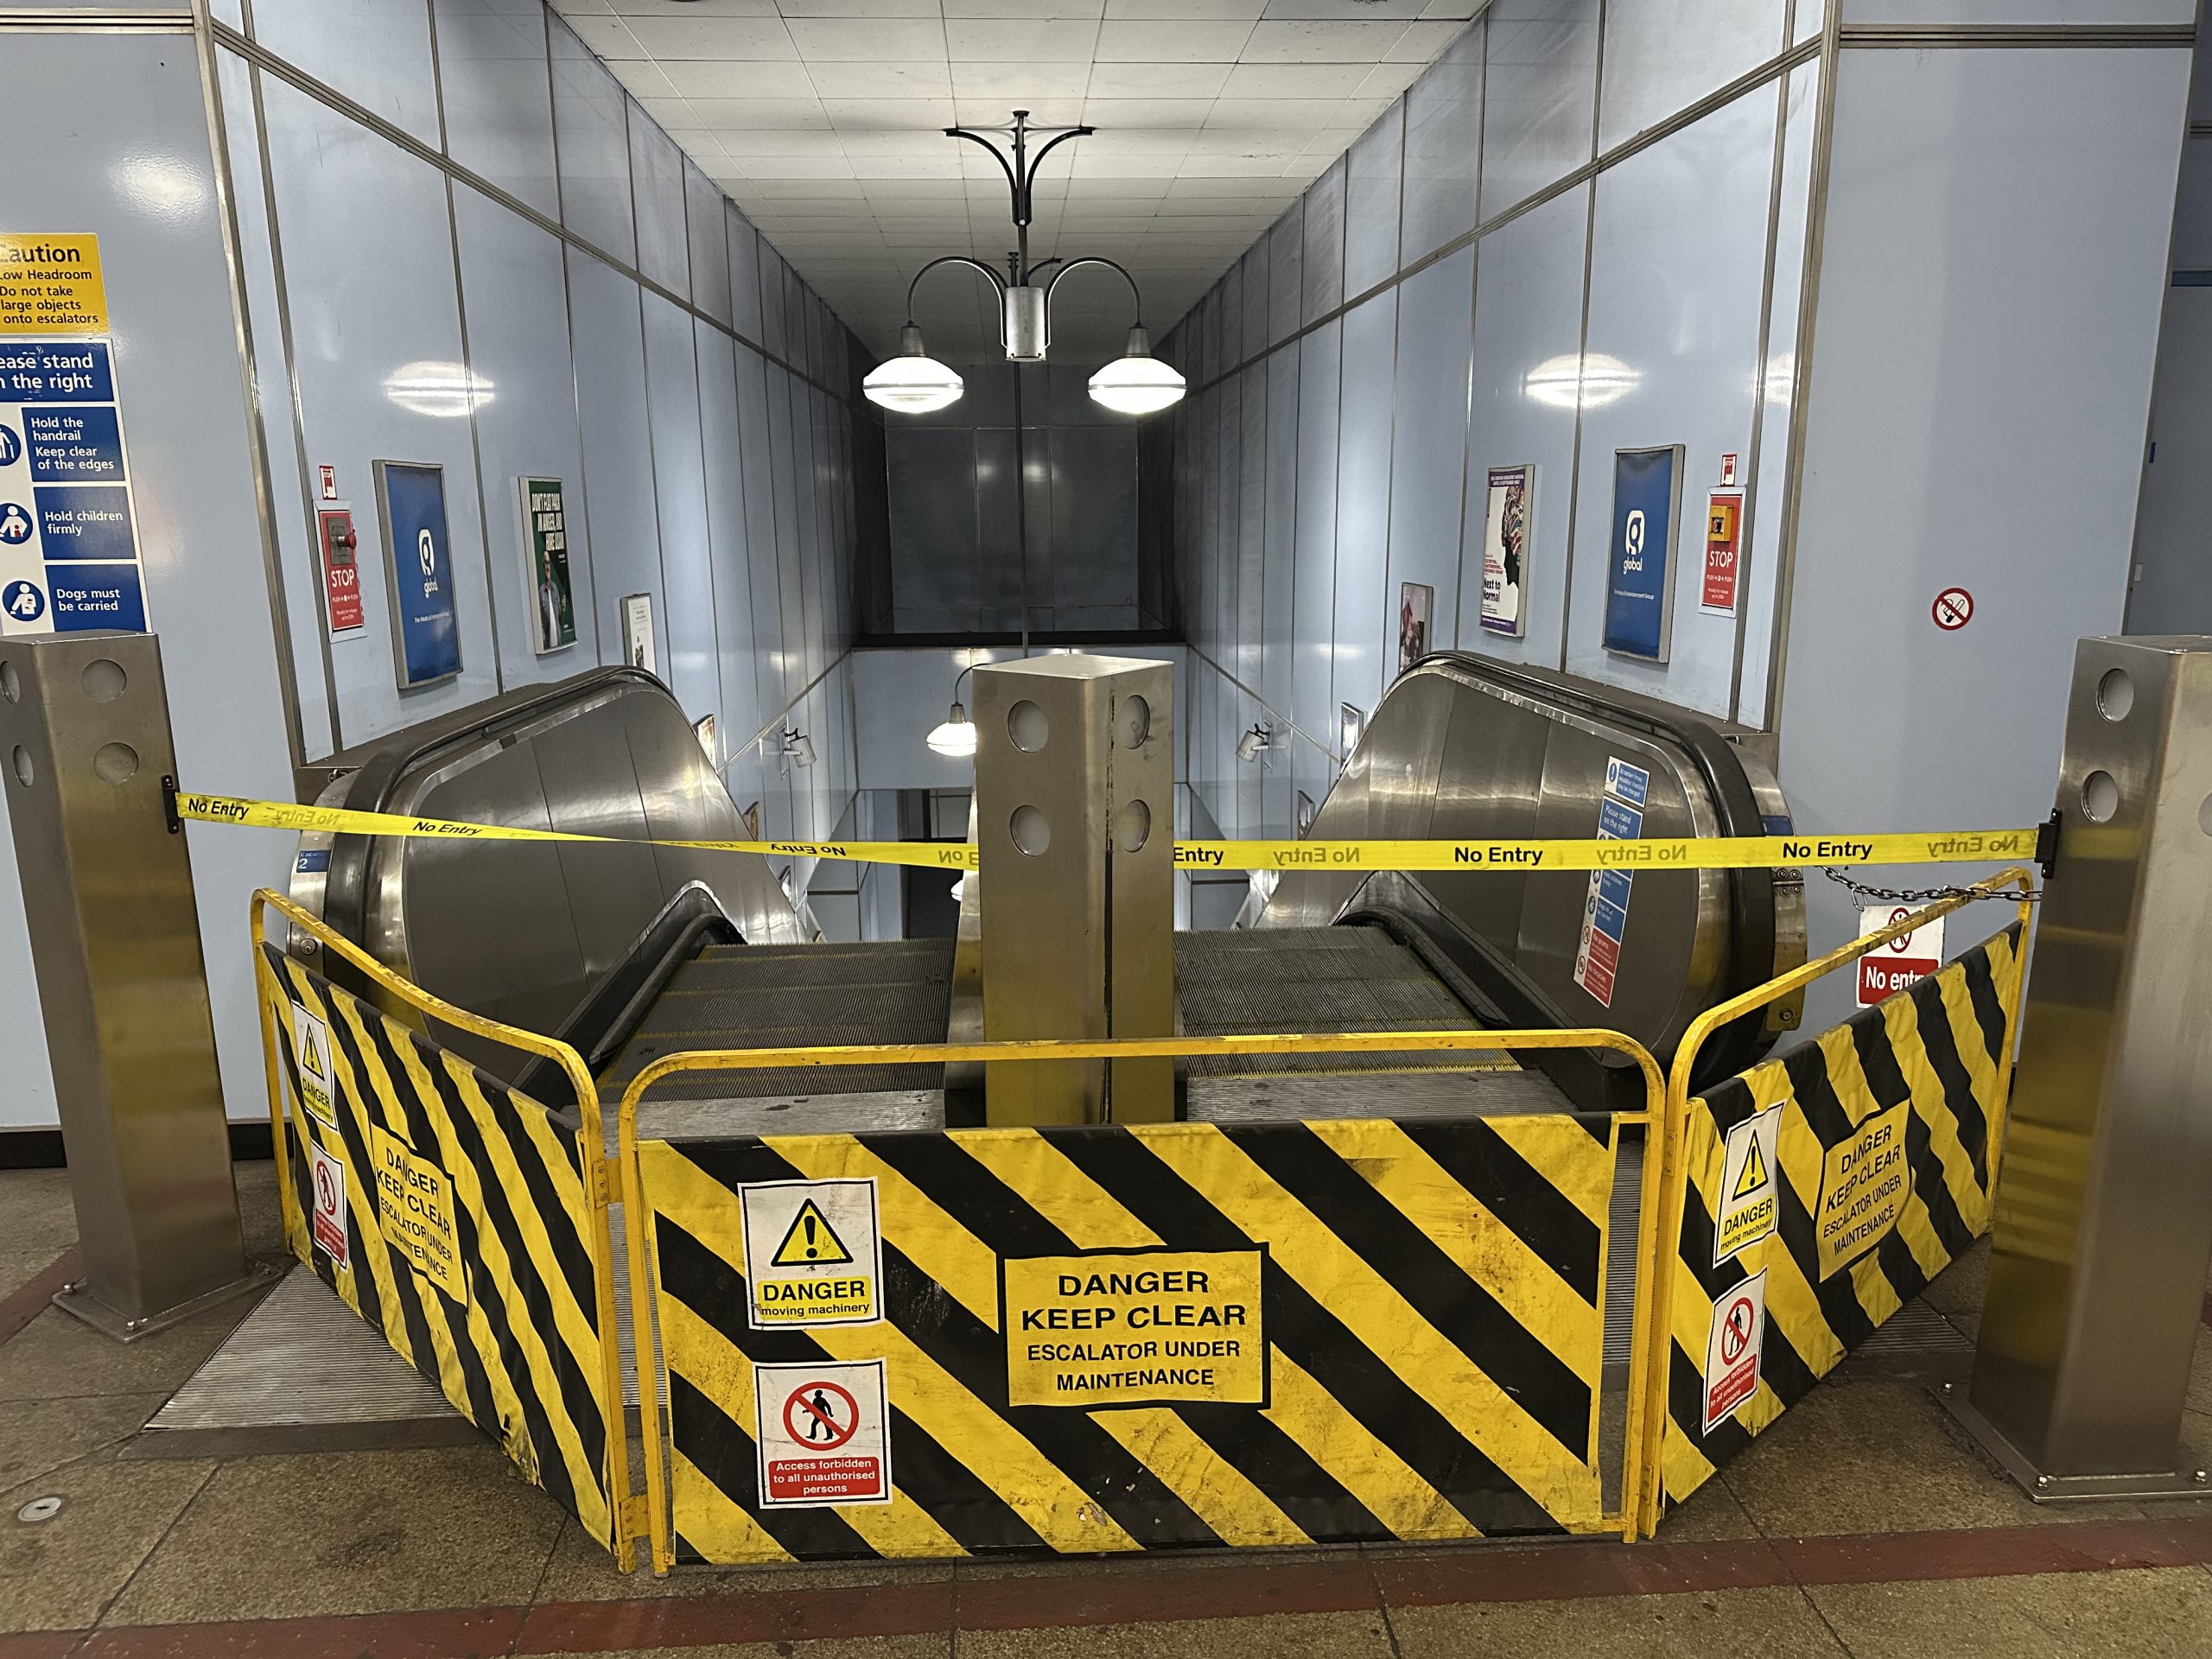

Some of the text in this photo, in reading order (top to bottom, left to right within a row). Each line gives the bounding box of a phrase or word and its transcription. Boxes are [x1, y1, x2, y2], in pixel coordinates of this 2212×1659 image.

[0, 243, 80, 263] aution
[28, 269, 92, 280] Headroom
[0, 285, 73, 296] Do not take
[1, 299, 81, 313] large objects
[3, 312, 99, 324] onto escalators
[42, 352, 93, 369] stand
[11, 372, 42, 389] the
[49, 372, 93, 392] right
[31, 416, 84, 428] Hold the
[33, 430, 81, 441] handrail
[35, 445, 98, 459] Keep clear
[38, 458, 114, 471] of the edges
[45, 510, 124, 521] Hold children
[48, 524, 82, 537] firmly
[1624, 556, 1643, 575] global
[1709, 550, 1733, 568] STOP
[331, 569, 354, 588] STOP
[56, 588, 121, 601] Dogs must
[59, 601, 118, 611] be carried
[188, 798, 250, 820] No Entry
[1605, 804, 1632, 824] Please stand
[413, 821, 482, 836] No Entry
[1603, 816, 1628, 835] on the right
[771, 843, 847, 856] No Entry
[1173, 847, 1224, 866] Entry
[1454, 847, 1543, 866] No Entry
[1783, 842, 1872, 861] No Entry
[298, 858, 308, 869] 2
[1866, 966, 1925, 991] No ent
[302, 1077, 331, 1110] DANGER
[1840, 1123, 1892, 1174] DANGER
[385, 1146, 440, 1196] DANGER
[1826, 1143, 1901, 1214] KEEP CLEAR
[376, 1166, 452, 1241] KEEP CLEAR
[1823, 1173, 1902, 1239] ESCALATOR UNDER
[1724, 1198, 1772, 1236] DANGER
[380, 1196, 454, 1265] ESCALATOR UNDER
[1720, 1217, 1773, 1251] moving machinery
[1834, 1203, 1895, 1256] MAINTENANCE
[763, 1280, 866, 1302] DANGER
[1058, 1270, 1209, 1296] DANGER
[761, 1303, 870, 1317] moving machinery
[1022, 1305, 1246, 1331] KEEP CLEAR
[1027, 1340, 1240, 1362] ESCALATOR UNDER
[1057, 1369, 1214, 1391] MAINTENANCE
[1713, 1376, 1731, 1396] Access
[1710, 1399, 1716, 1408] to
[1721, 1388, 1741, 1410] persons
[776, 1459, 872, 1471] Access forbidden
[773, 1471, 875, 1483] to all unauthorised
[803, 1484, 848, 1496] persons
